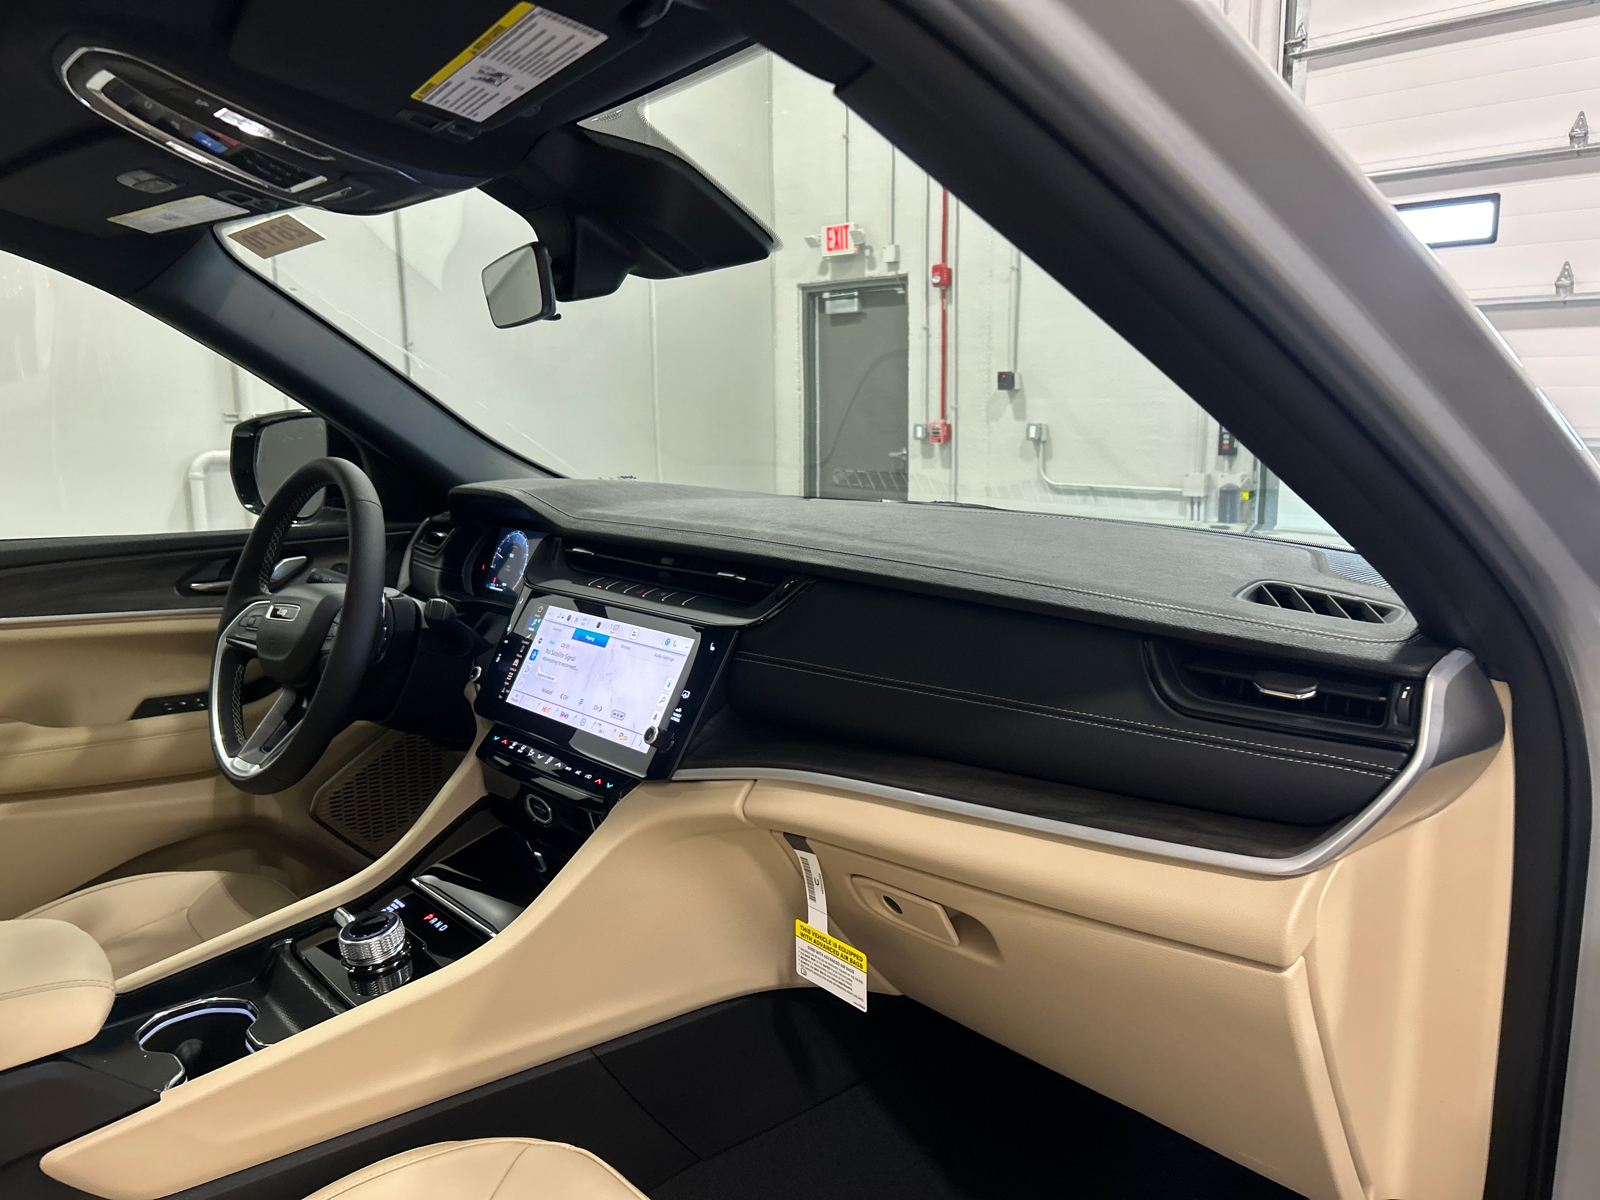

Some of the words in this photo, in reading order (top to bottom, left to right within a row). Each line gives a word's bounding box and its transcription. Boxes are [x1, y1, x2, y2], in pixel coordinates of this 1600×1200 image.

[826, 224, 849, 251] EXIT
[610, 623, 620, 631] 1:07
[585, 634, 596, 642] Playing
[551, 649, 565, 659] Satellite
[564, 653, 577, 662] Signal
[653, 652, 663, 660] Audio
[800, 925, 811, 934] THIS
[812, 930, 831, 946] VEHICLE
[838, 944, 863, 962] EQUIPPED
[799, 931, 813, 942] WITH
[813, 938, 840, 957] ADVANCED
[840, 953, 849, 962] AIR
[849, 957, 864, 970] BAGS
[823, 953, 841, 966] ADVANCED
